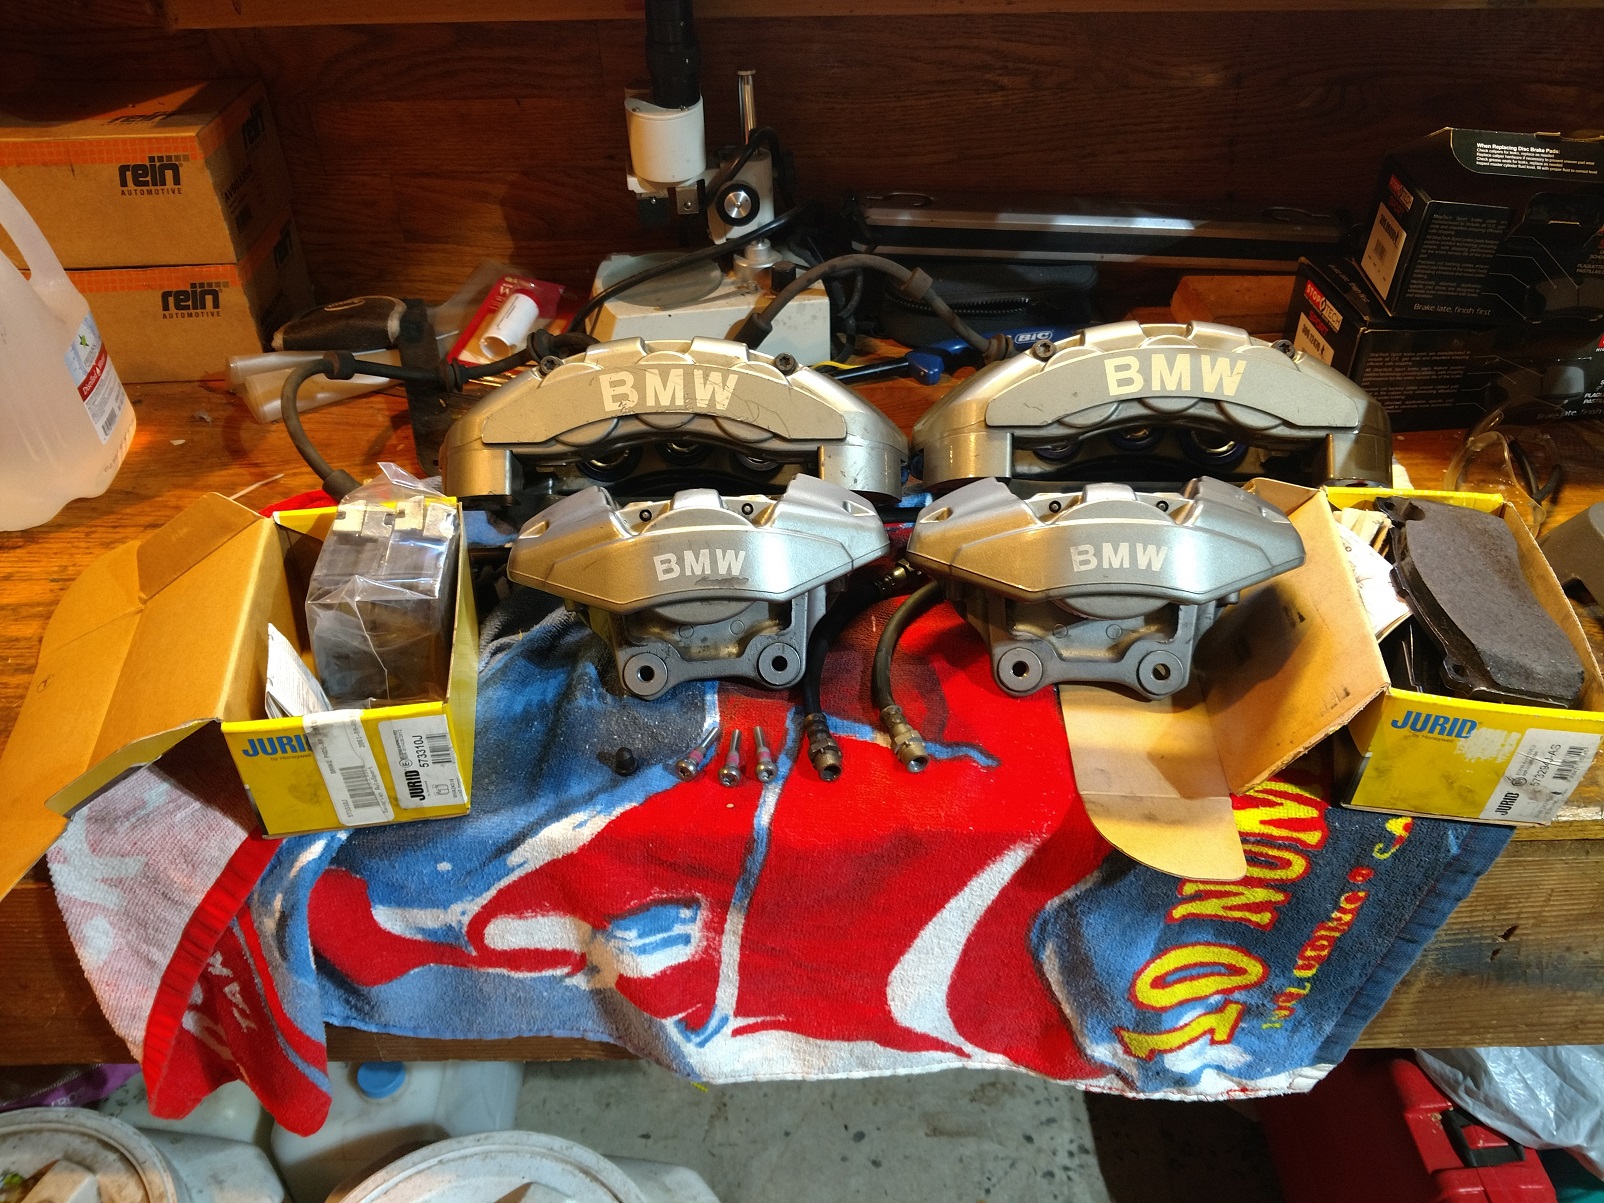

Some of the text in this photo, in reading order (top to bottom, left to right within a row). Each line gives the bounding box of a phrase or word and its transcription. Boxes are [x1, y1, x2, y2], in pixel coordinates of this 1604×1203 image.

[1492, 144, 1517, 152] Replacing
[118, 156, 181, 187] rein
[121, 188, 182, 196] AUTOMOTIVE
[161, 283, 220, 311] rein
[1413, 302, 1436, 312] Brake
[1454, 305, 1475, 316] finish
[1475, 307, 1491, 316] first
[162, 311, 221, 319] AUTOMOTIVE
[1018, 332, 1050, 341] BIC
[599, 368, 738, 412] BMW
[1104, 353, 1247, 397] BMW
[653, 549, 746, 582] BMW
[1070, 542, 1167, 573] BMW
[1391, 710, 1478, 739] JURID
[412, 734, 430, 768] 573310J
[404, 769, 426, 802] JURID
[1494, 791, 1520, 816] JURID
[1113, 943, 1269, 1061] 10
